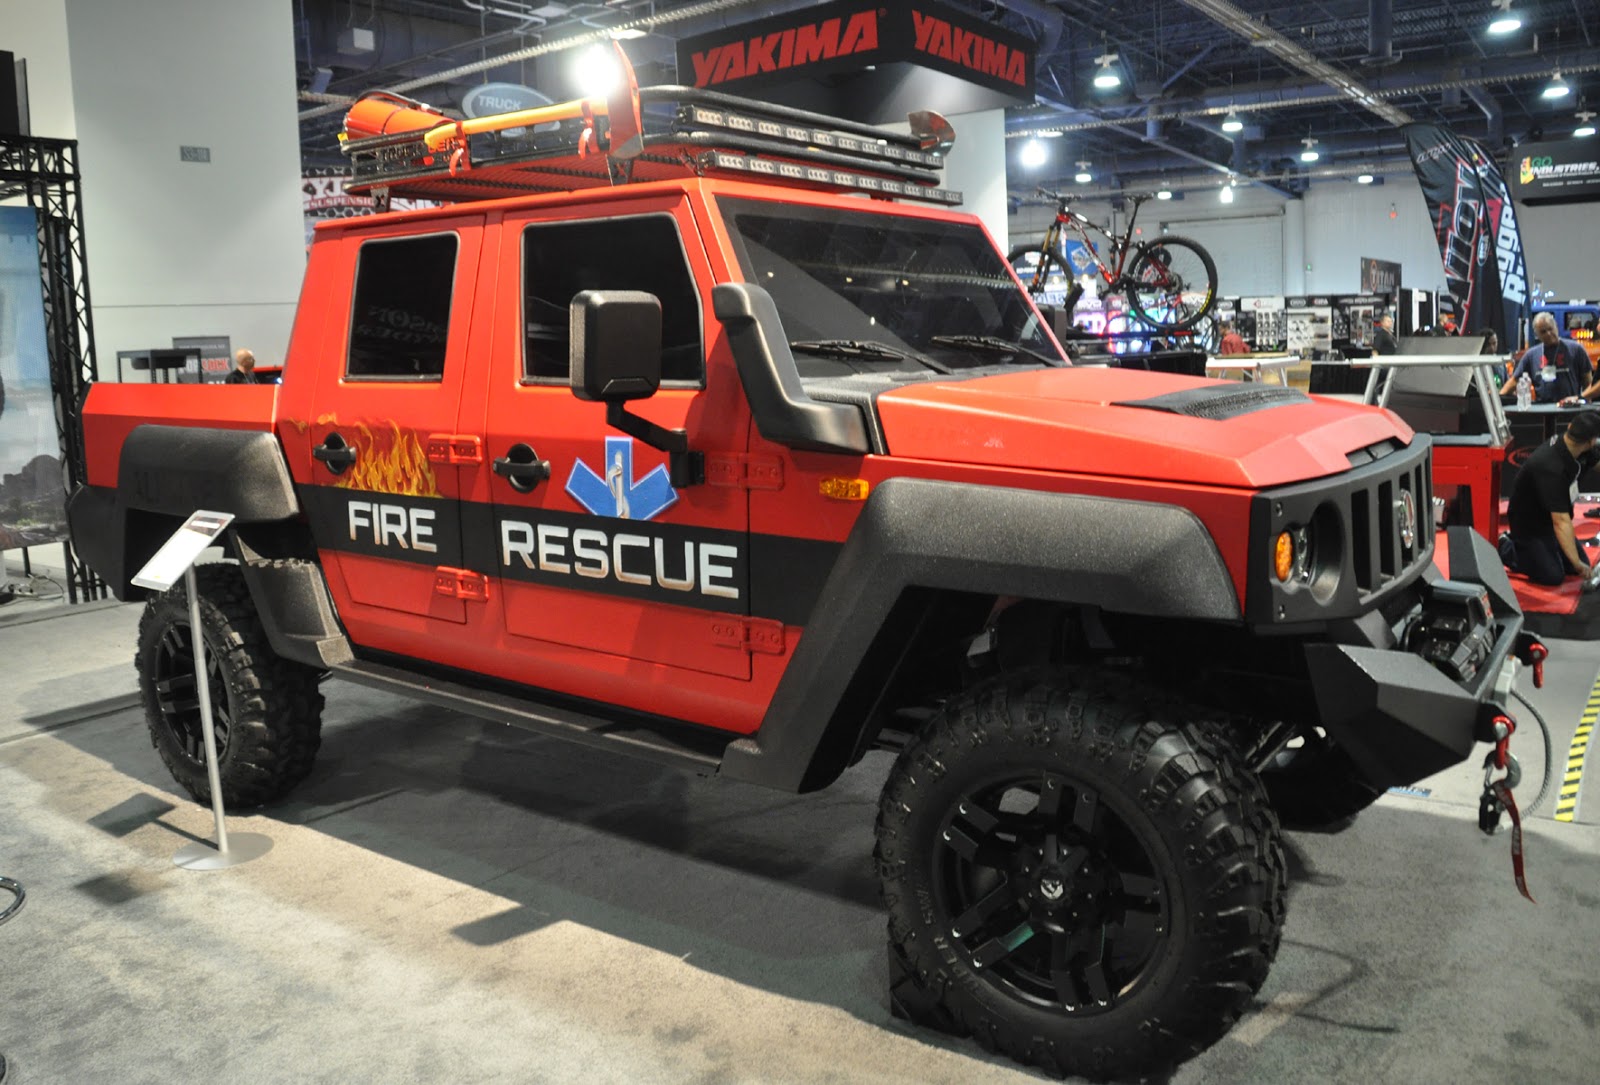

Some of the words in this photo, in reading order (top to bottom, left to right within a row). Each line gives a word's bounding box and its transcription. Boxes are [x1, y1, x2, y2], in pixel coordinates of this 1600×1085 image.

[691, 9, 878, 89] YAKIMA
[911, 9, 1026, 87] YAKIMA
[477, 95, 522, 110] TRUCK
[348, 500, 437, 553] FIRE
[501, 519, 740, 600] RESCUE
